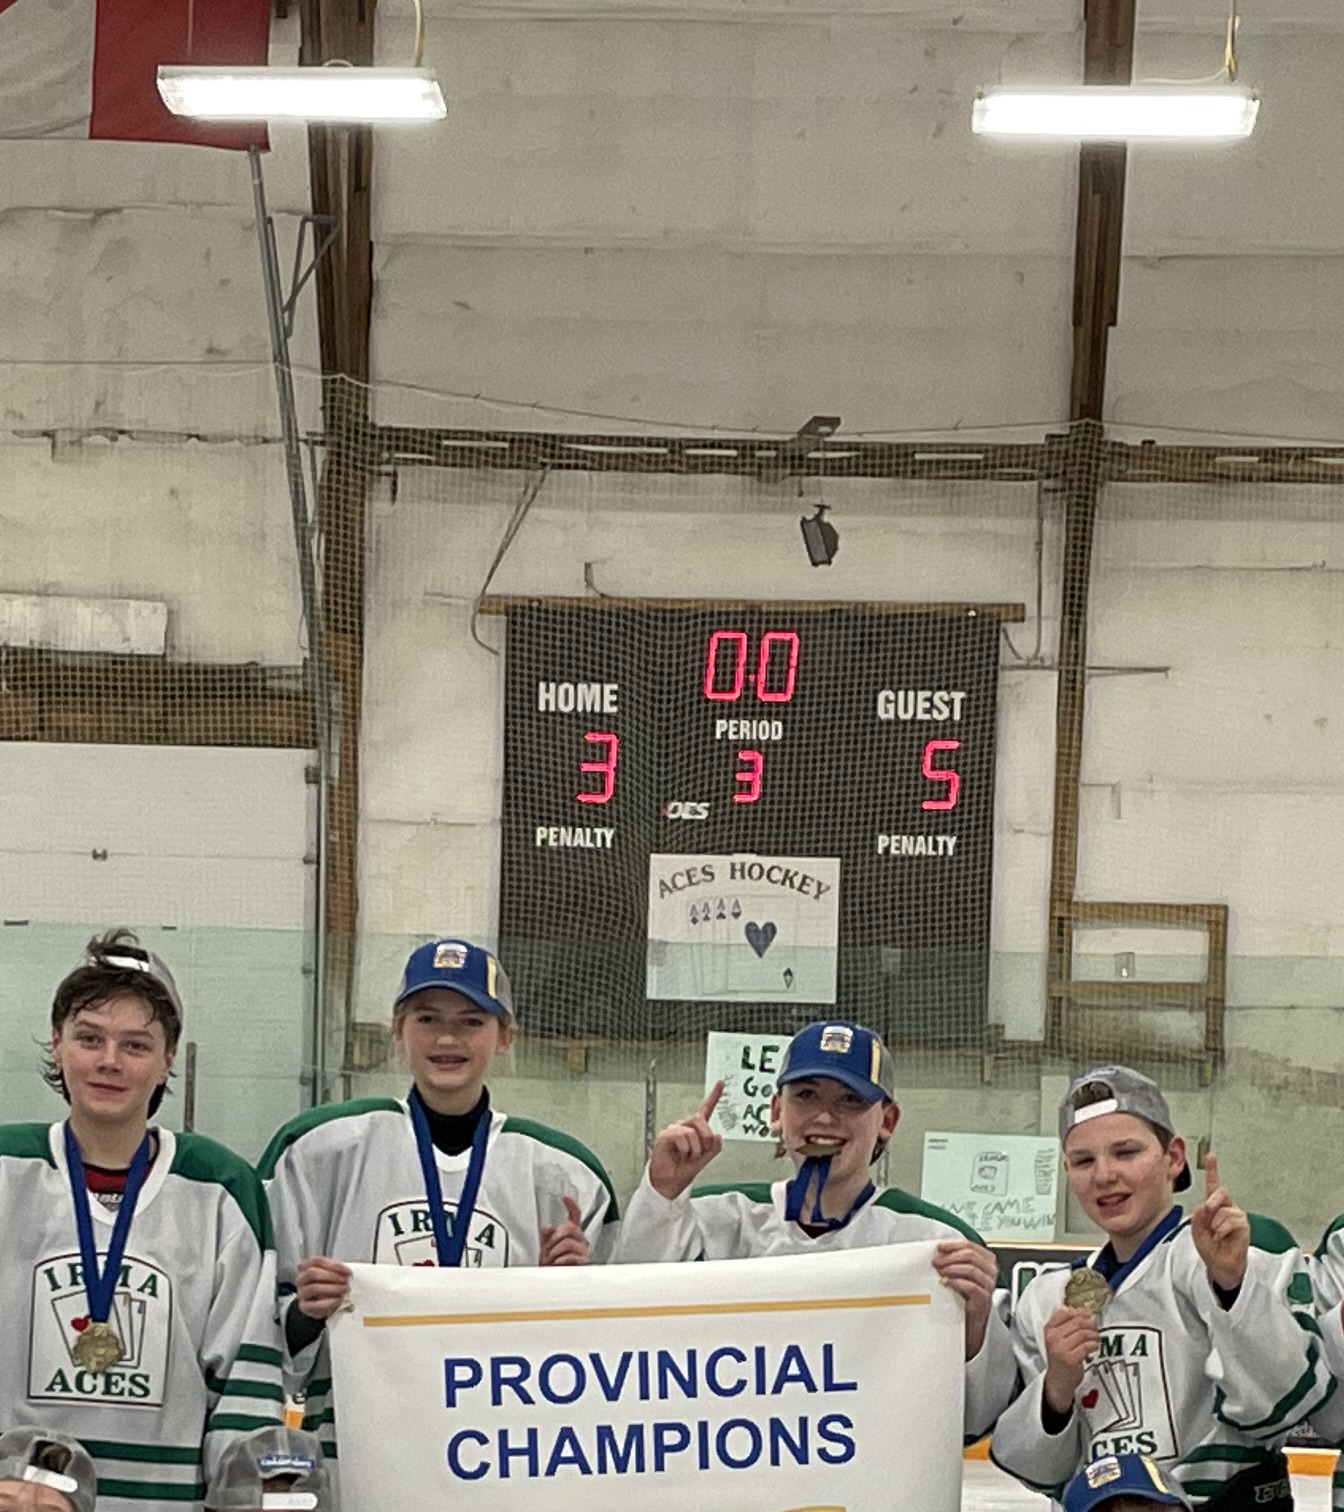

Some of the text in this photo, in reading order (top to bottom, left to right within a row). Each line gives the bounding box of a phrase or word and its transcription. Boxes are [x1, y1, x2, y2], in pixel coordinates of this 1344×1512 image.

[537, 682, 619, 714] HOME
[876, 690, 966, 721] GUEST
[715, 719, 783, 741] PERIOD
[576, 732, 620, 803] 3
[732, 750, 764, 803] 3
[921, 739, 961, 811] 5
[535, 827, 616, 850] PENALTY
[876, 834, 957, 857] PENALTY
[657, 861, 832, 901] ACES HOCKEY
[741, 1044, 780, 1074] LE
[742, 1103, 771, 1126] AC
[388, 1208, 496, 1249] IRA
[44, 1367, 152, 1398] ACES
[443, 1343, 859, 1409] PROVINCIAL
[446, 1413, 857, 1480] CHAMPIONS
[1090, 1430, 1159, 1461] CES
